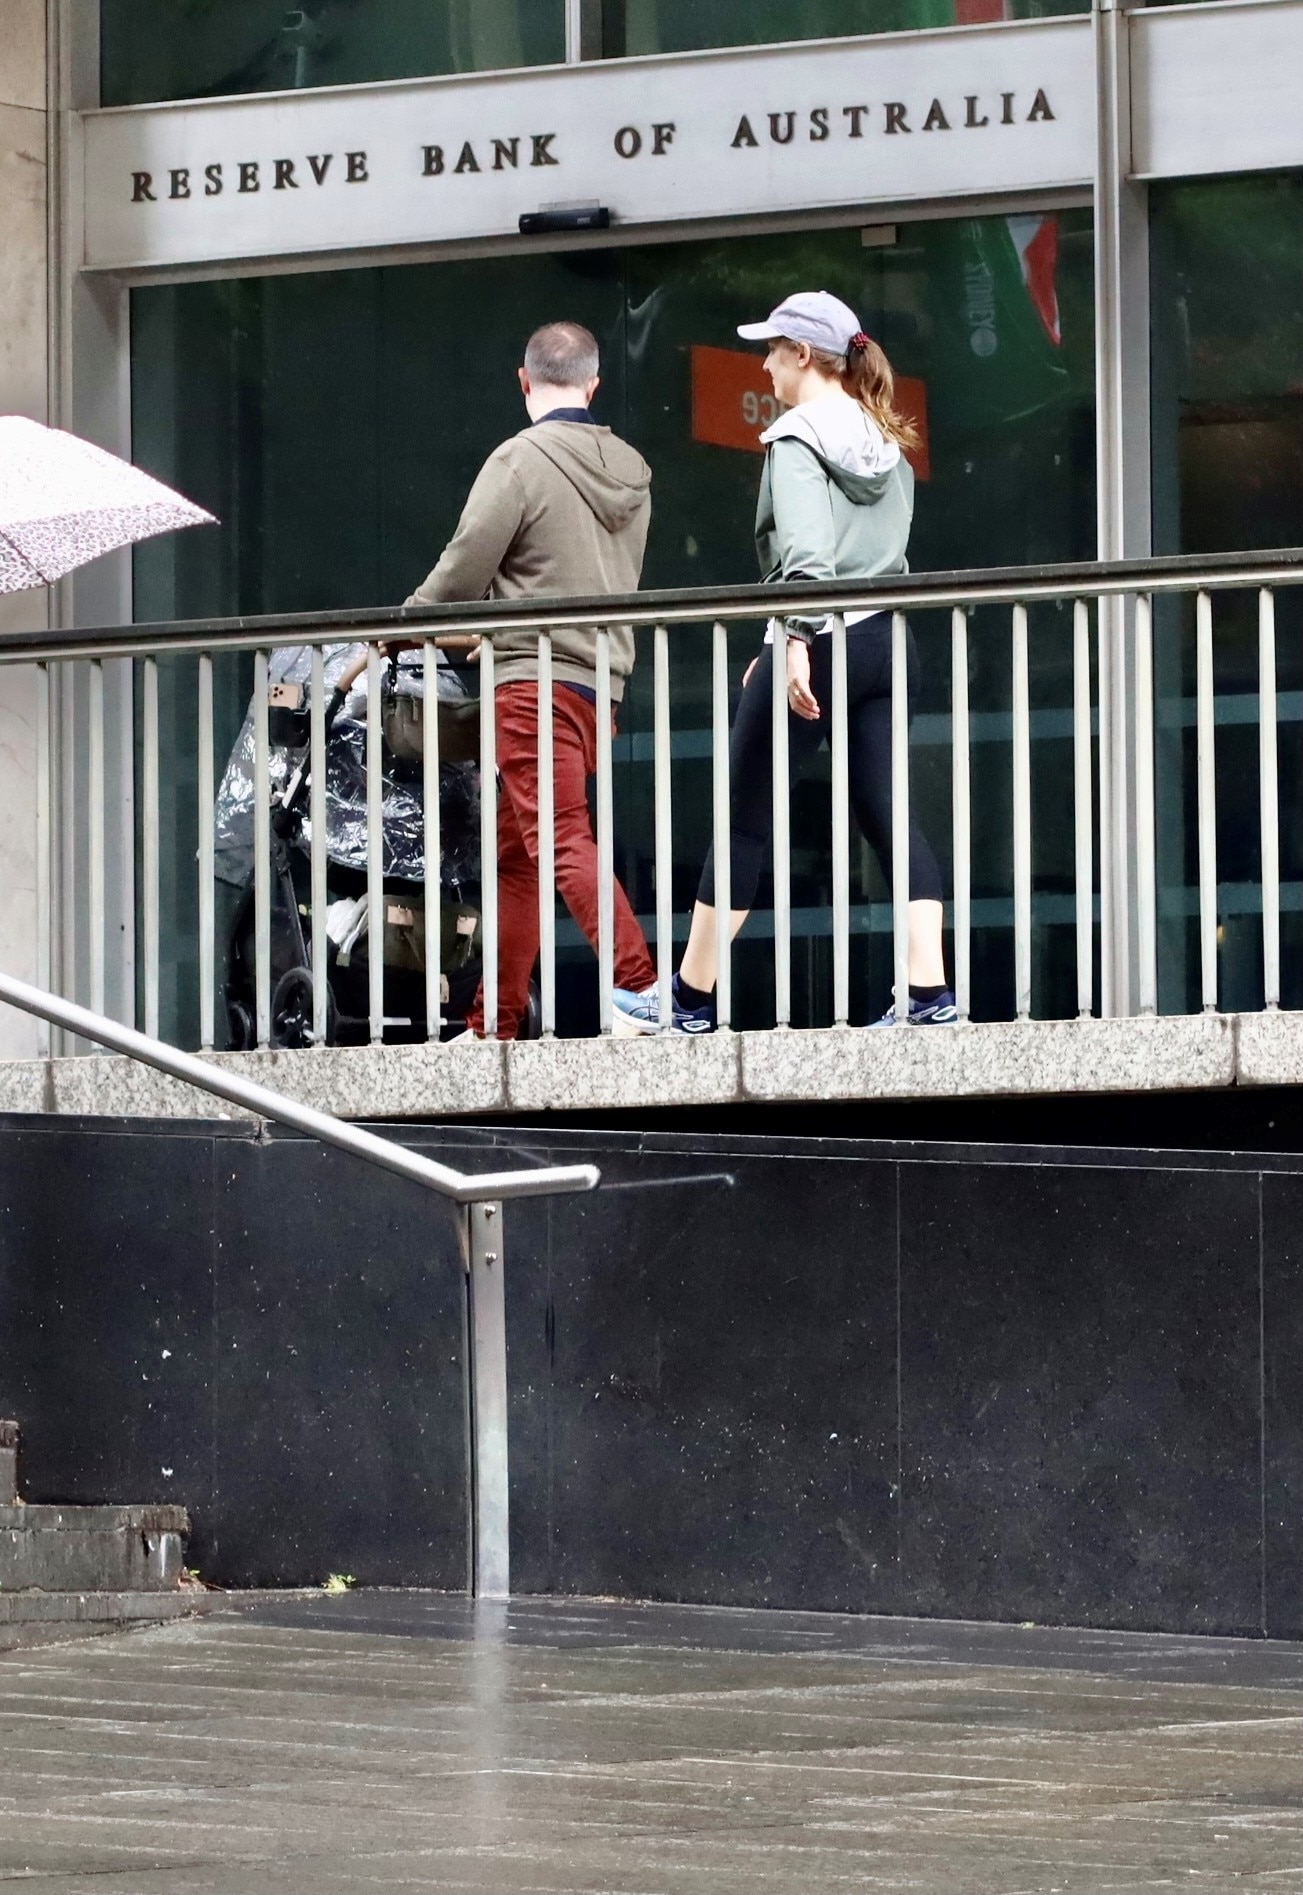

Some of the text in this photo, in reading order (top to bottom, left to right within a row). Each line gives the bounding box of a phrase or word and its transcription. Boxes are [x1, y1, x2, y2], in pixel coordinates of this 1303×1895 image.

[129, 88, 1057, 204] RESERVE BANK OF AUSTRALIA
